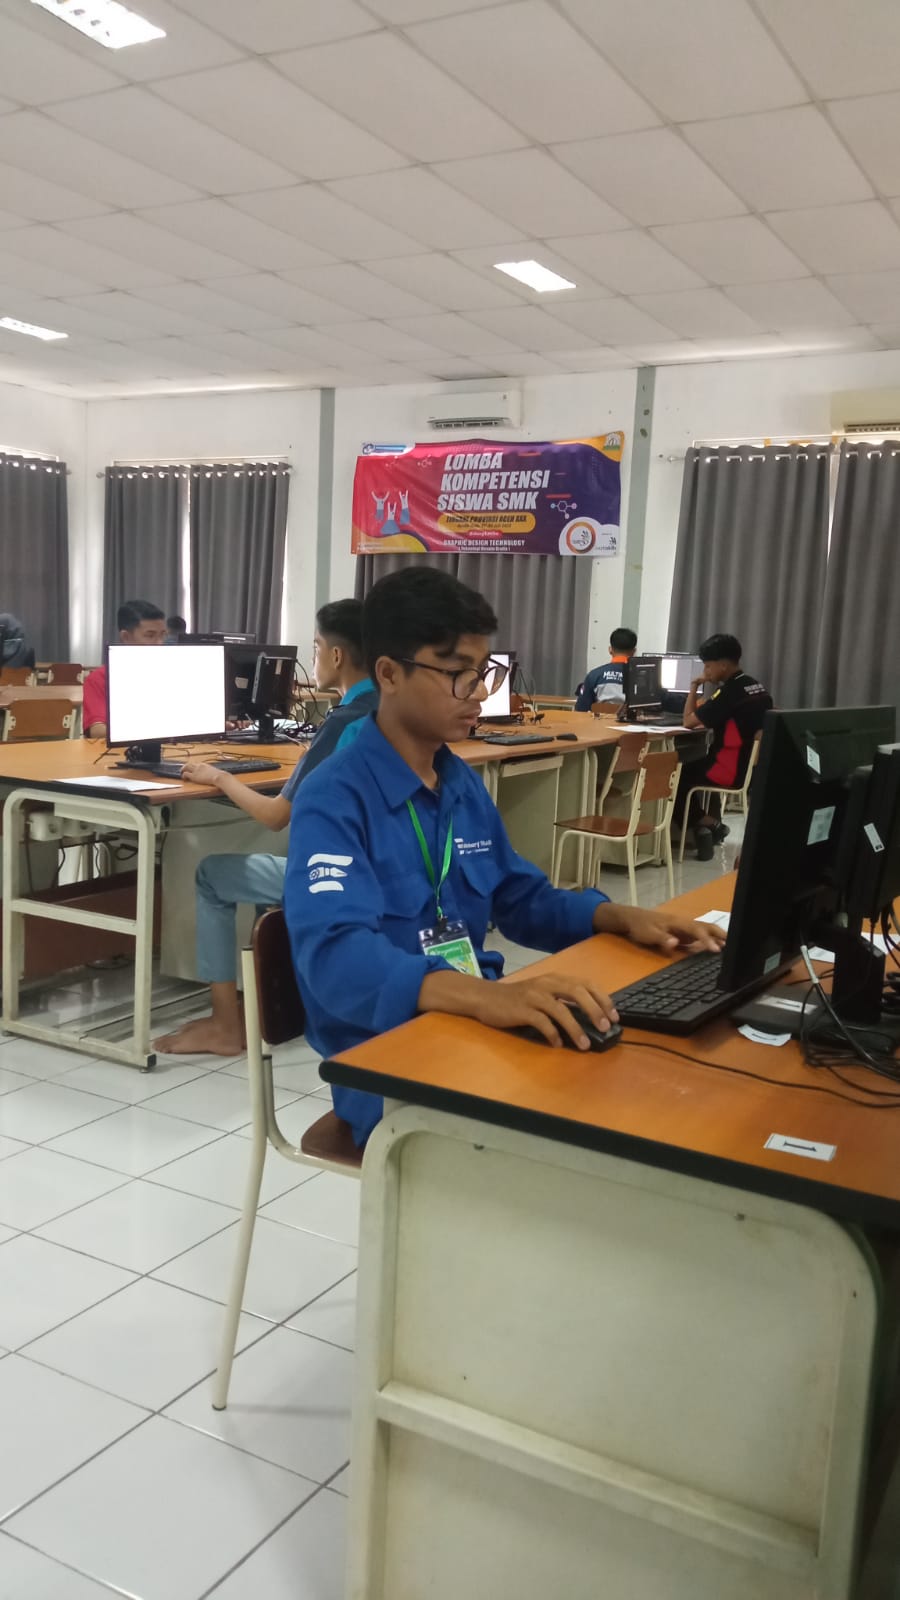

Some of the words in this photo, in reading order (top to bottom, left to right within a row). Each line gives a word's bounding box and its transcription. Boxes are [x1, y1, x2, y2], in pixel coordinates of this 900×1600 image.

[444, 452, 503, 471] LOMBA
[440, 470, 551, 491] KOMPETENSI
[437, 493, 493, 511] SISWA
[496, 491, 540, 510] SMK
